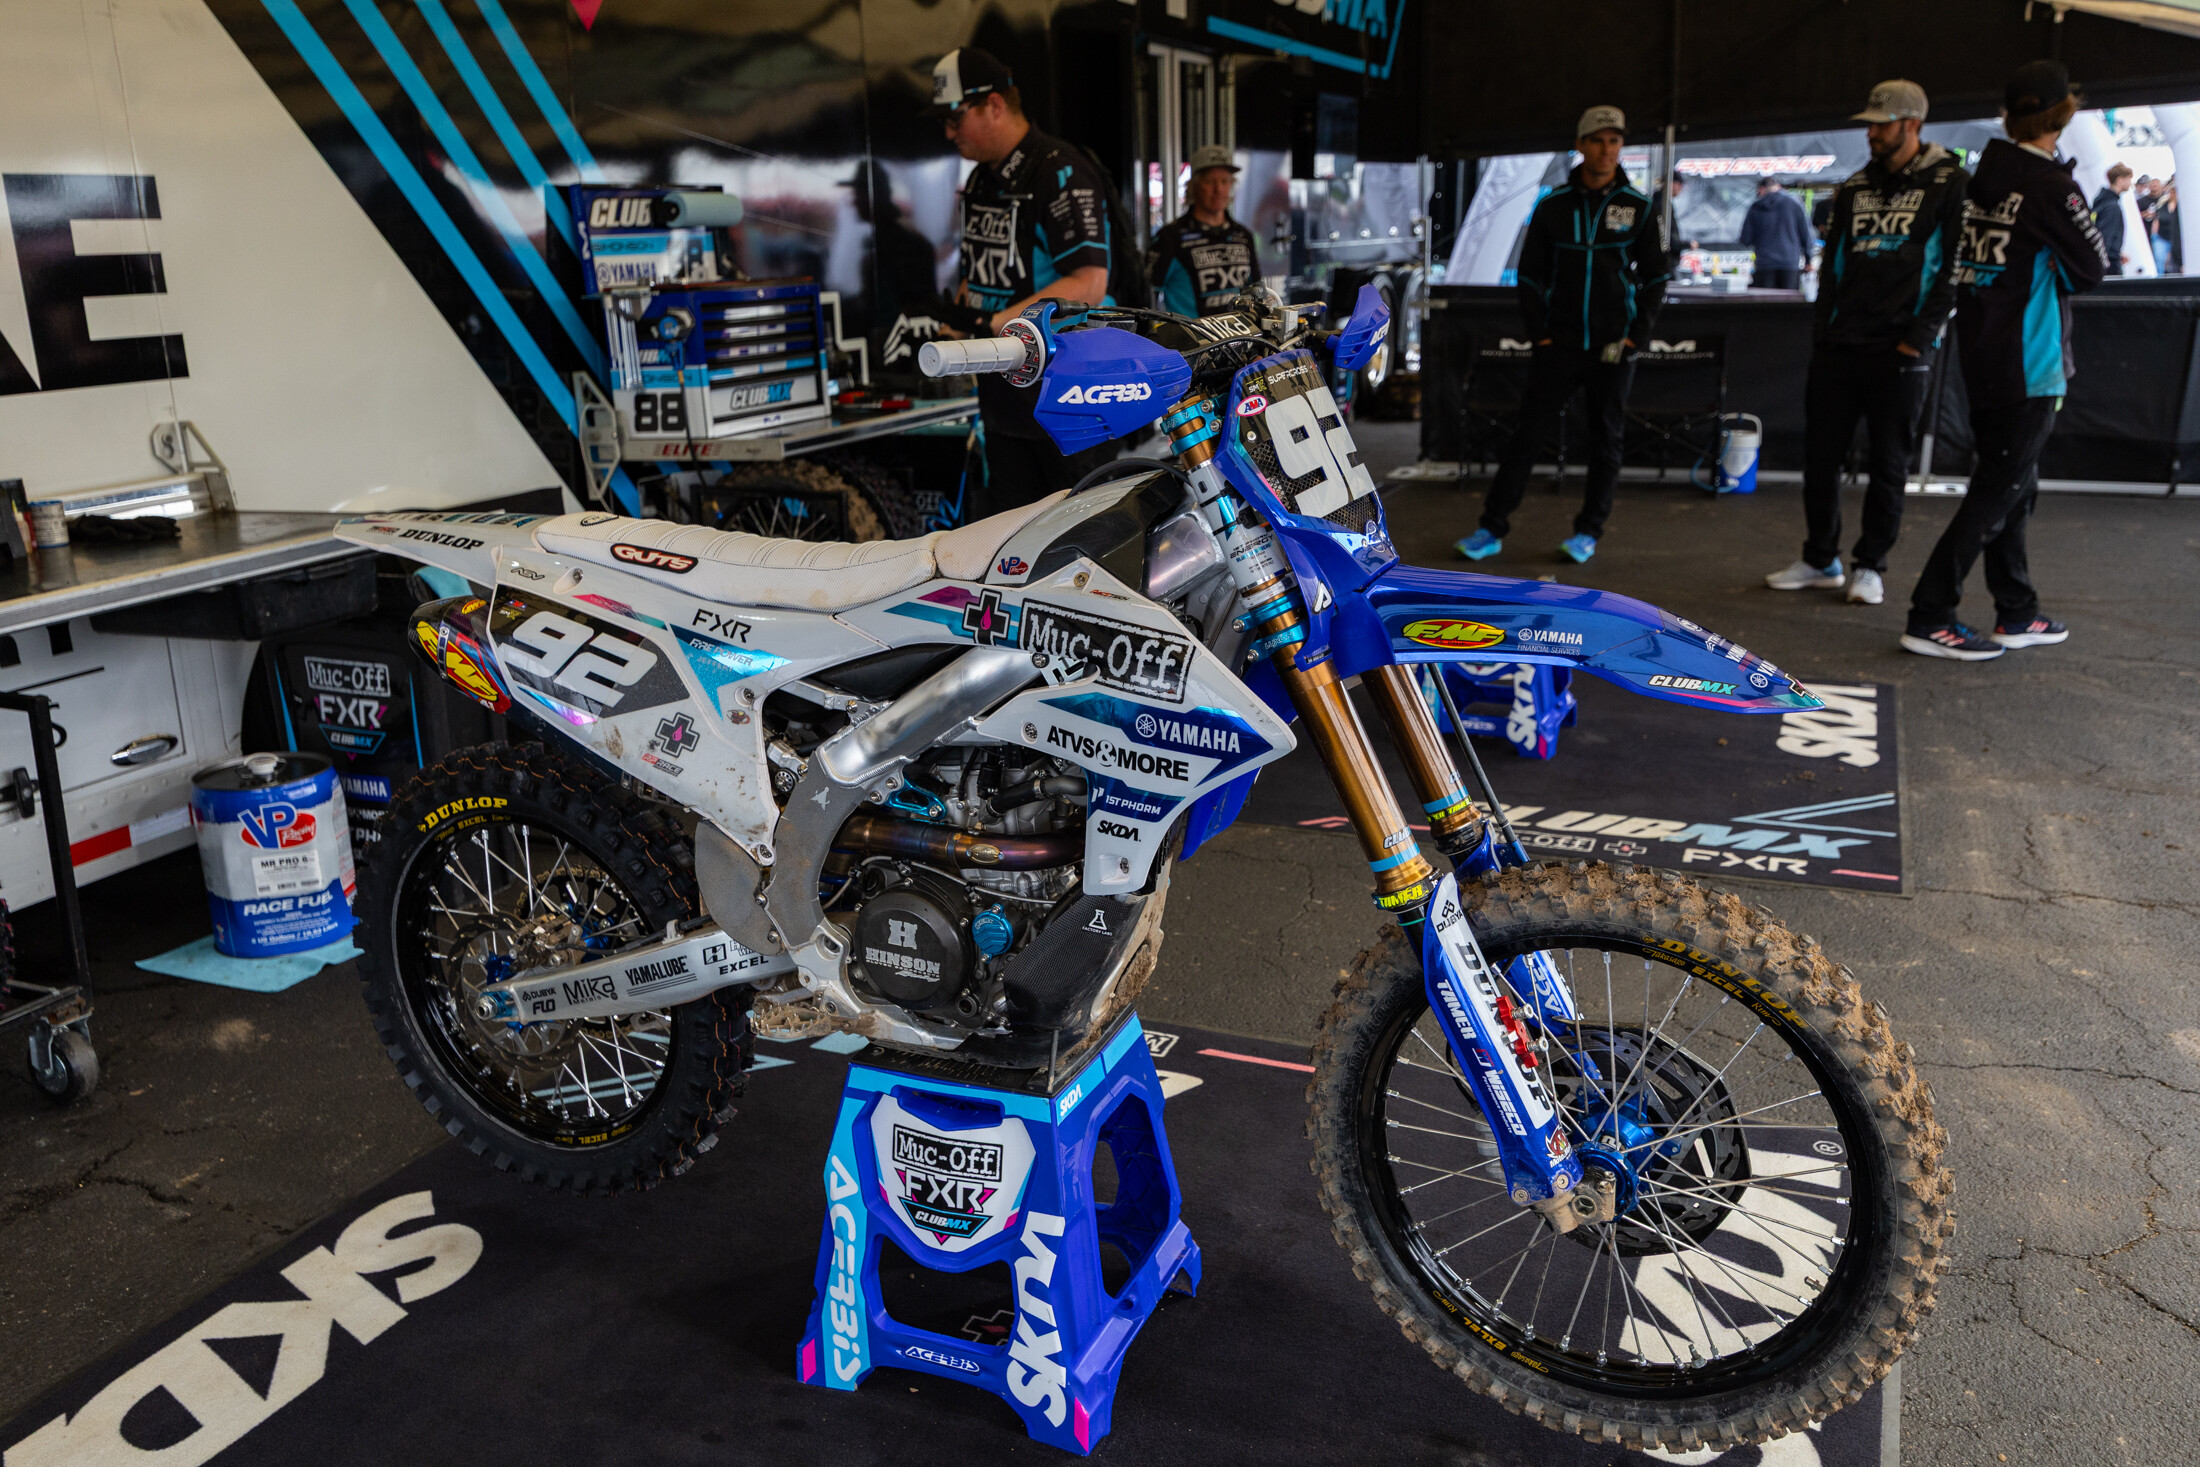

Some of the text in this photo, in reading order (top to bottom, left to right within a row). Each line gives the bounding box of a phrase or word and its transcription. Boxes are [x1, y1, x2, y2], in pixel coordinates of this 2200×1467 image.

[589, 198, 653, 229] CLUB
[1852, 212, 1916, 238] FXR
[0, 173, 190, 396] E
[1268, 365, 1308, 385] SUPERCROSS
[730, 382, 794, 411] CLUBMX
[1057, 382, 1153, 405] ACERBIS
[635, 393, 686, 432] 88
[662, 444, 711, 457] ELITE
[1265, 386, 1377, 518] 92
[399, 528, 484, 551] DUNLOP
[613, 545, 694, 571] GUTS
[692, 608, 752, 643] FXR
[1403, 623, 1505, 643] FMF
[1533, 629, 1583, 645] YAMAHA
[498, 611, 658, 708] 92
[714, 645, 754, 667] POWER
[1027, 613, 1186, 690] Muc-Off
[1517, 644, 1581, 656] FINANCIAL SERVICES
[311, 661, 386, 690] Muc-Off
[1649, 673, 1739, 697] CLUBMX
[318, 695, 382, 728] FXR
[329, 731, 374, 748] CLUBMX
[1159, 718, 1241, 754] YAMAHA
[656, 759, 683, 774] RACE
[1047, 725, 1189, 781] ATVS&MORE
[341, 777, 387, 797] YAMAHA
[424, 796, 508, 829] DUNLOP
[1121, 797, 1161, 815] PHORM
[237, 802, 298, 849] VP
[1097, 819, 1141, 842] SKDA
[1383, 825, 1412, 849] CLUB
[1682, 849, 1808, 875] FXR
[243, 891, 334, 917] RACE FUEL
[1082, 926, 1113, 937] FACTORY LABS
[1436, 910, 1464, 933] DUBYA
[625, 956, 689, 986] YAMALUBE
[718, 955, 769, 976] EXCEL
[865, 947, 941, 975] HINSON
[1642, 948, 1686, 966] Takasago
[1691, 965, 1744, 999] EXCEL
[530, 987, 556, 1000] DUBYA
[562, 975, 616, 1006] Mika
[1657, 937, 1809, 1030] DUNLOP
[1437, 979, 1476, 1040] TAMER
[1060, 1083, 1082, 1117] SKDA
[1484, 1069, 1527, 1137] WISECO
[897, 1133, 996, 1177] Muc-Off
[904, 1173, 988, 1213] FXR
[914, 1210, 973, 1231] CLUBMX
[828, 1154, 862, 1382] ACERBIS
[1007, 1210, 1067, 1429] SKDA
[1463, 1316, 1508, 1351] EXCEL
[905, 1346, 980, 1372] ACERBIS
